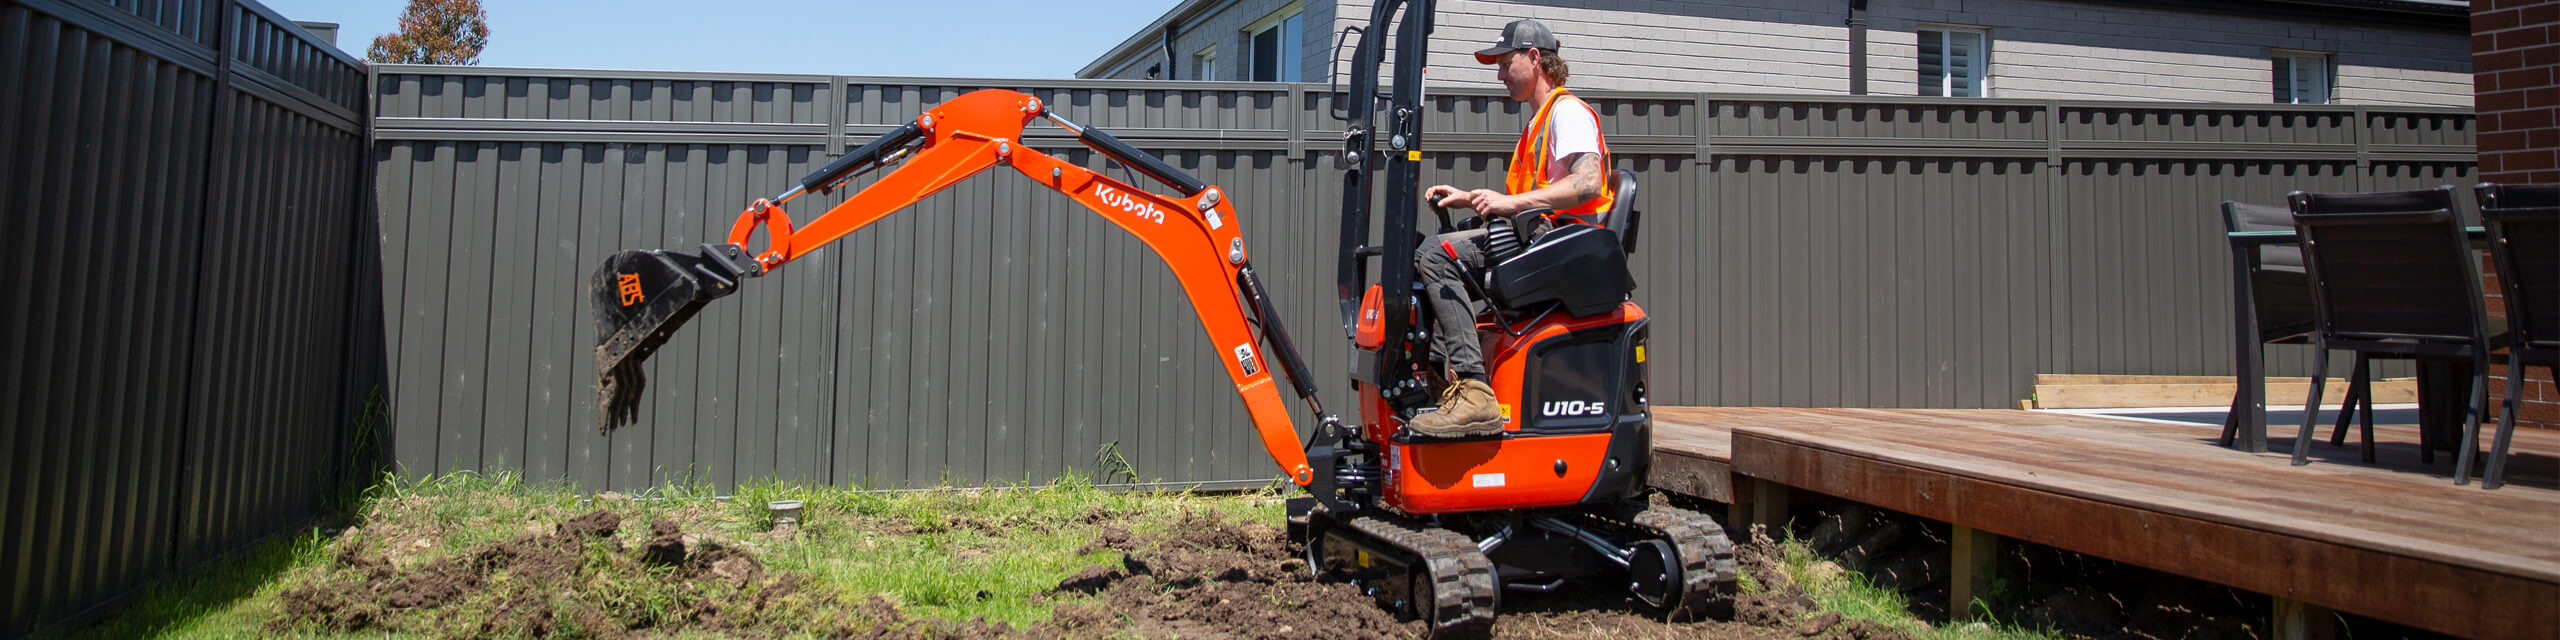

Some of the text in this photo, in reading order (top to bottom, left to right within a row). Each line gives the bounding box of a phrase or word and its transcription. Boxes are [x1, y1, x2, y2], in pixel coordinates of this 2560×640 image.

[1095, 183, 1165, 224] Kubota
[617, 272, 644, 307] ABS
[1543, 400, 1605, 416] U10-5
